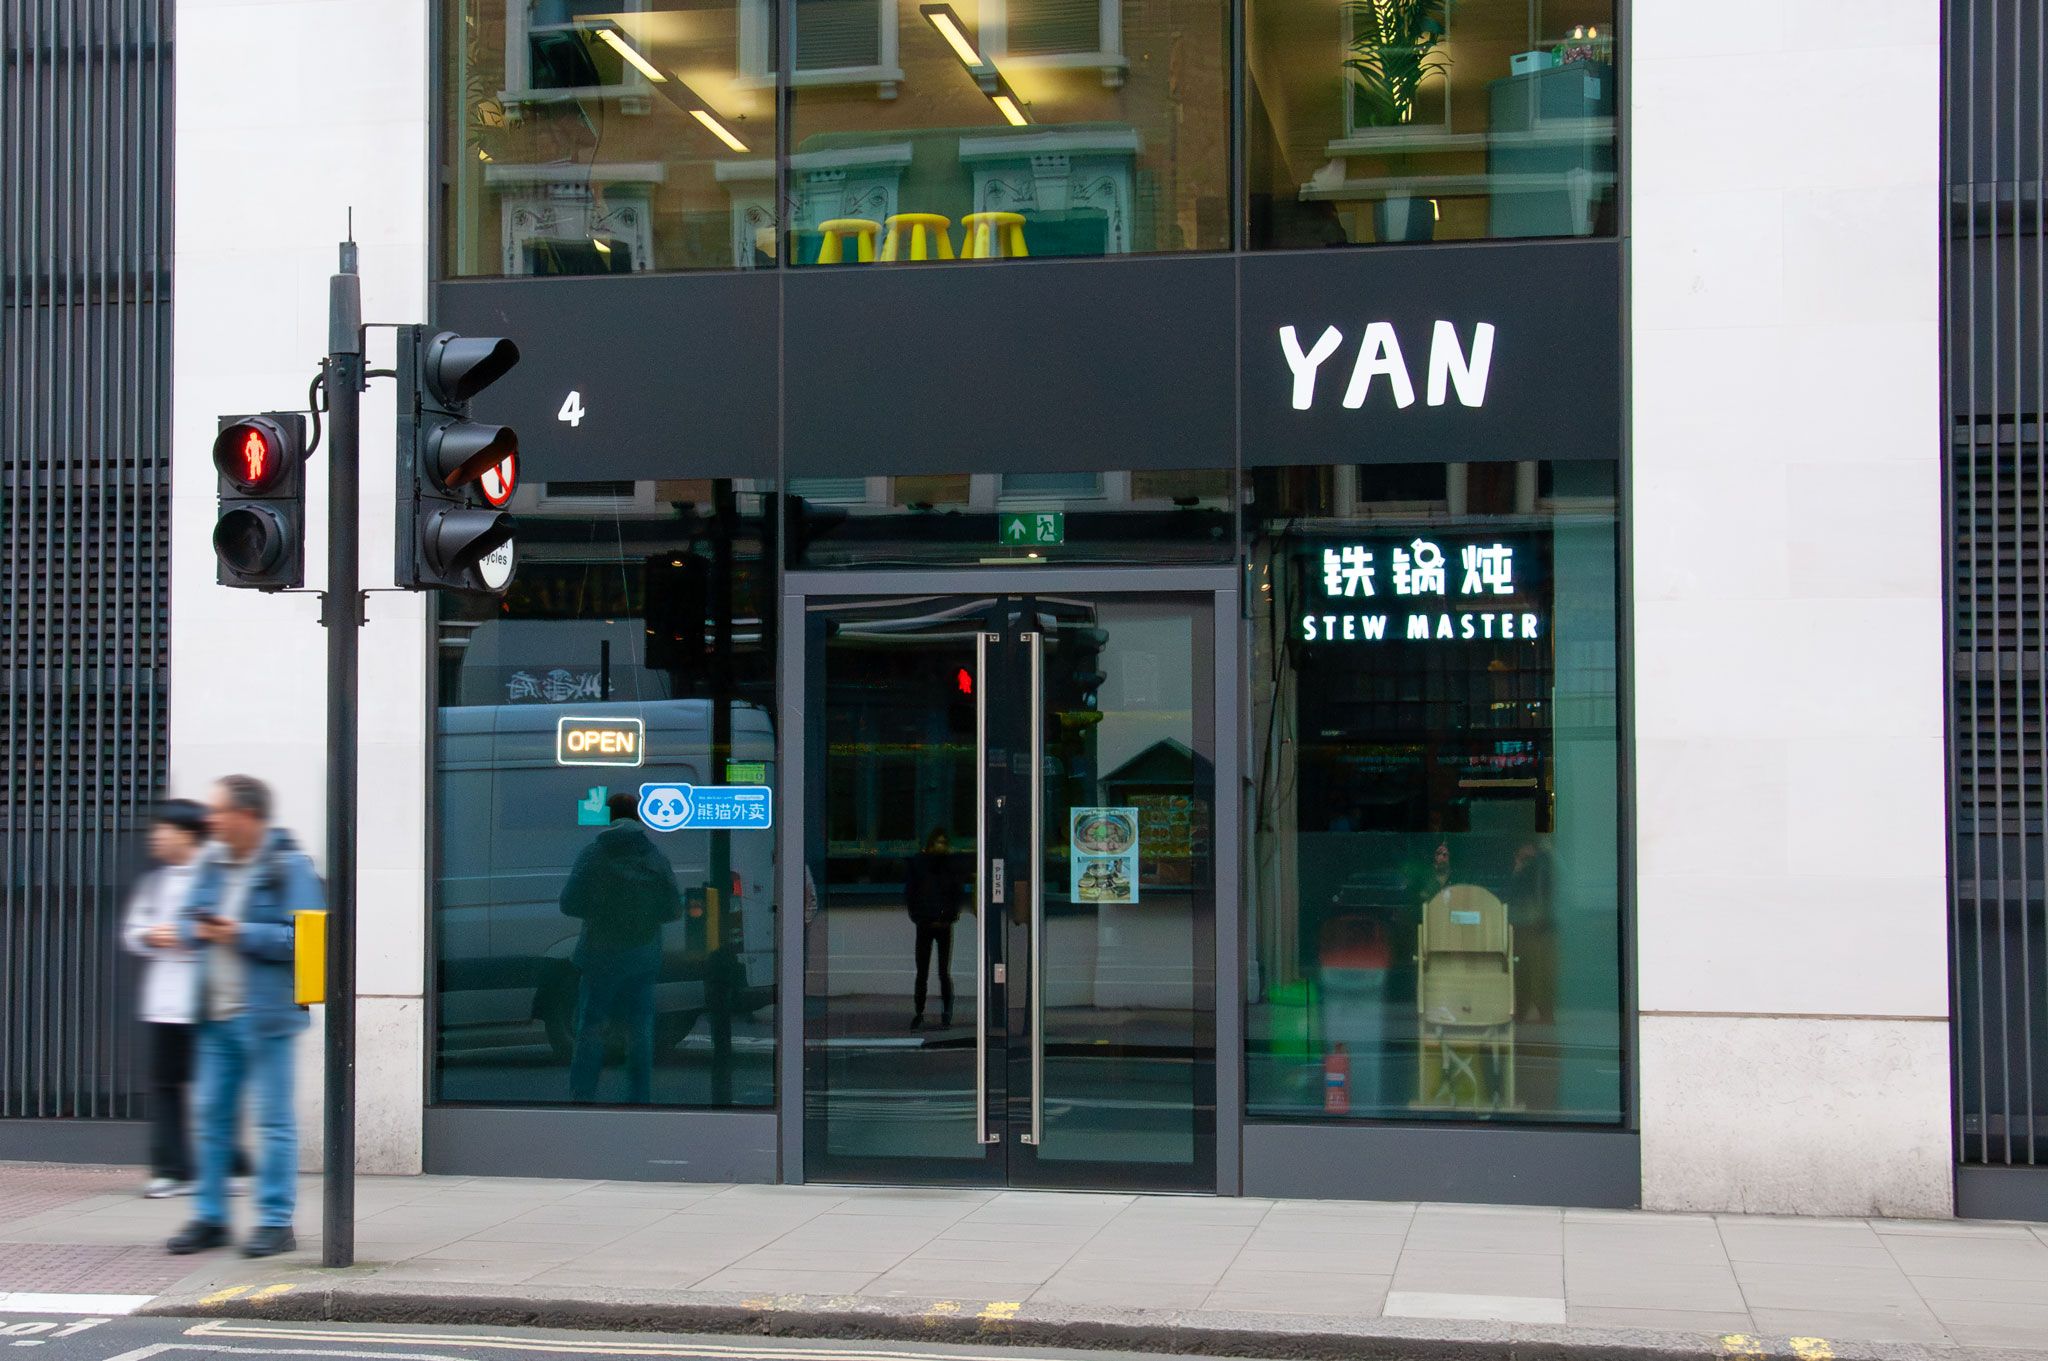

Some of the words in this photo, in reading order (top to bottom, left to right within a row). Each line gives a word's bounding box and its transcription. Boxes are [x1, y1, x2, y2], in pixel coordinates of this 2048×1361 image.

[1279, 320, 1495, 411] YAN
[557, 390, 586, 428] 4
[1323, 538, 1515, 597] 铁锅炖
[1302, 614, 1387, 641] STEW
[1406, 612, 1539, 640] MASTER
[566, 729, 635, 753] OPEN
[697, 803, 765, 820] 熊猫外卖
[994, 866, 1003, 896] PUSH
